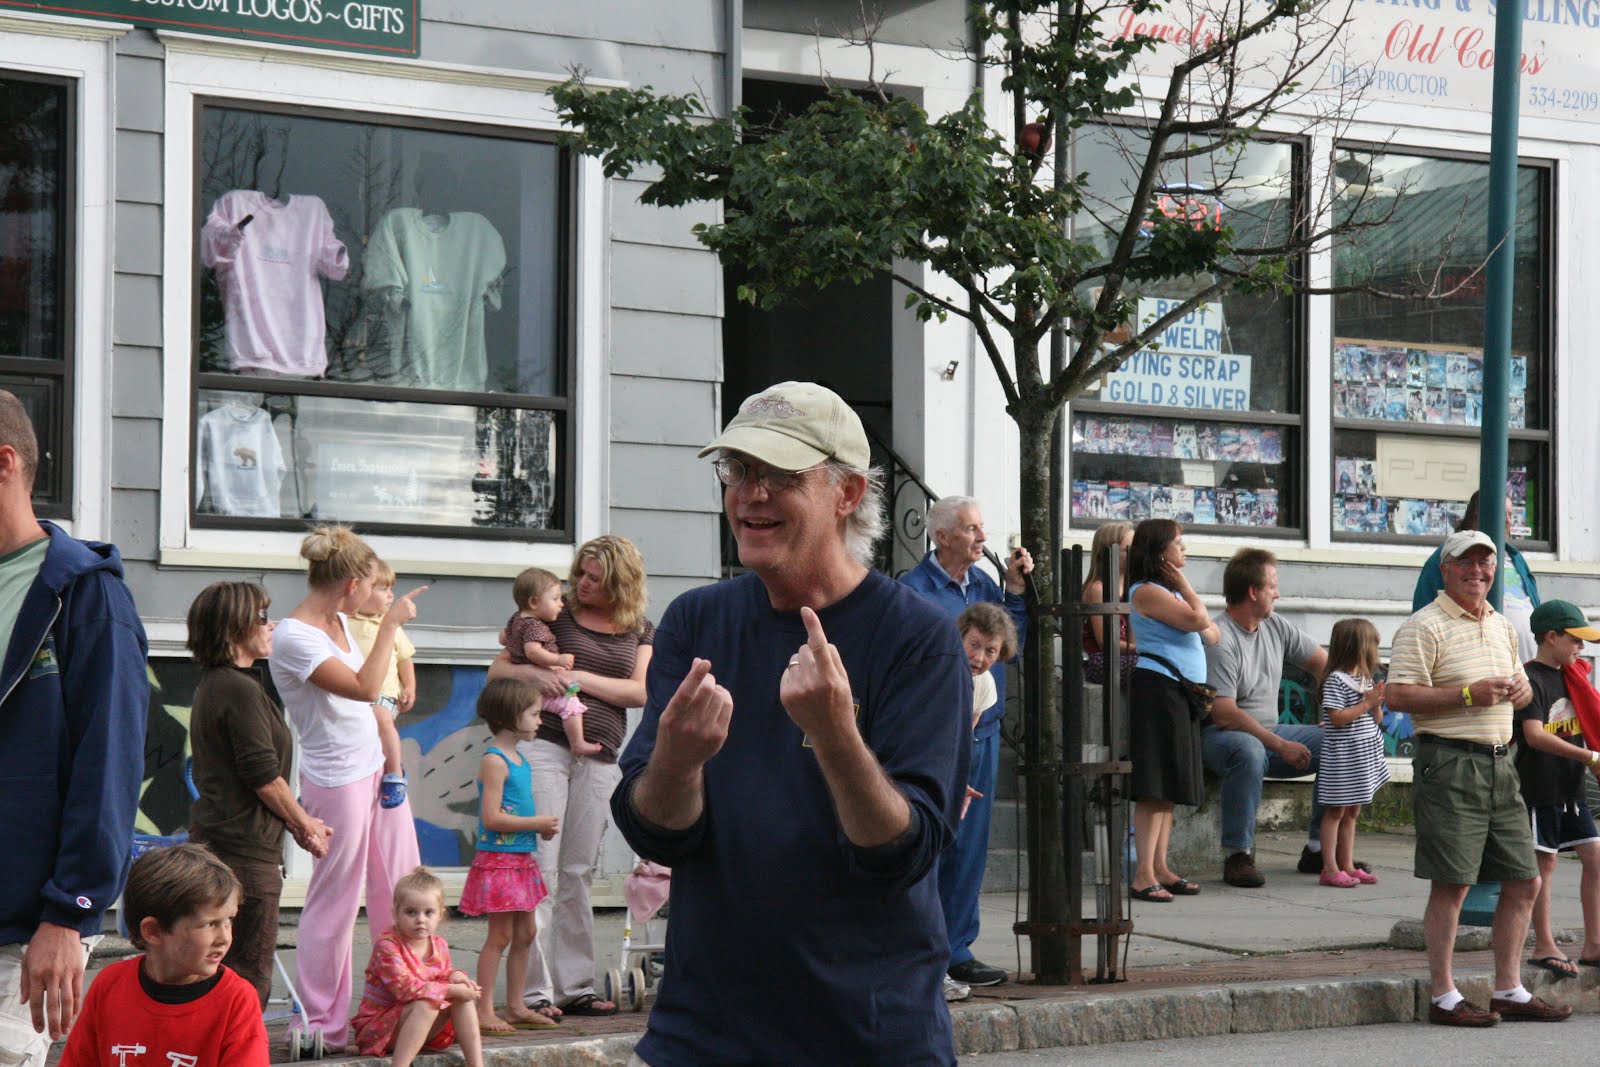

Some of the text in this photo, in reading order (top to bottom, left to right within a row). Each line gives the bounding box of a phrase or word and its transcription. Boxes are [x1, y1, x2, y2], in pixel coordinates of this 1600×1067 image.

[1107, 4, 1228, 66] Jewelr
[1385, 19, 1550, 75] Old Cos
[1378, 69, 1449, 97] PROCTOR
[1528, 86, 1599, 111] 334-2209
[1154, 325, 1222, 352] WELRY
[1119, 350, 1241, 381] YING SCRAP
[1109, 379, 1246, 411] GOLD & SILVER
[1388, 459, 1468, 482] PS2
